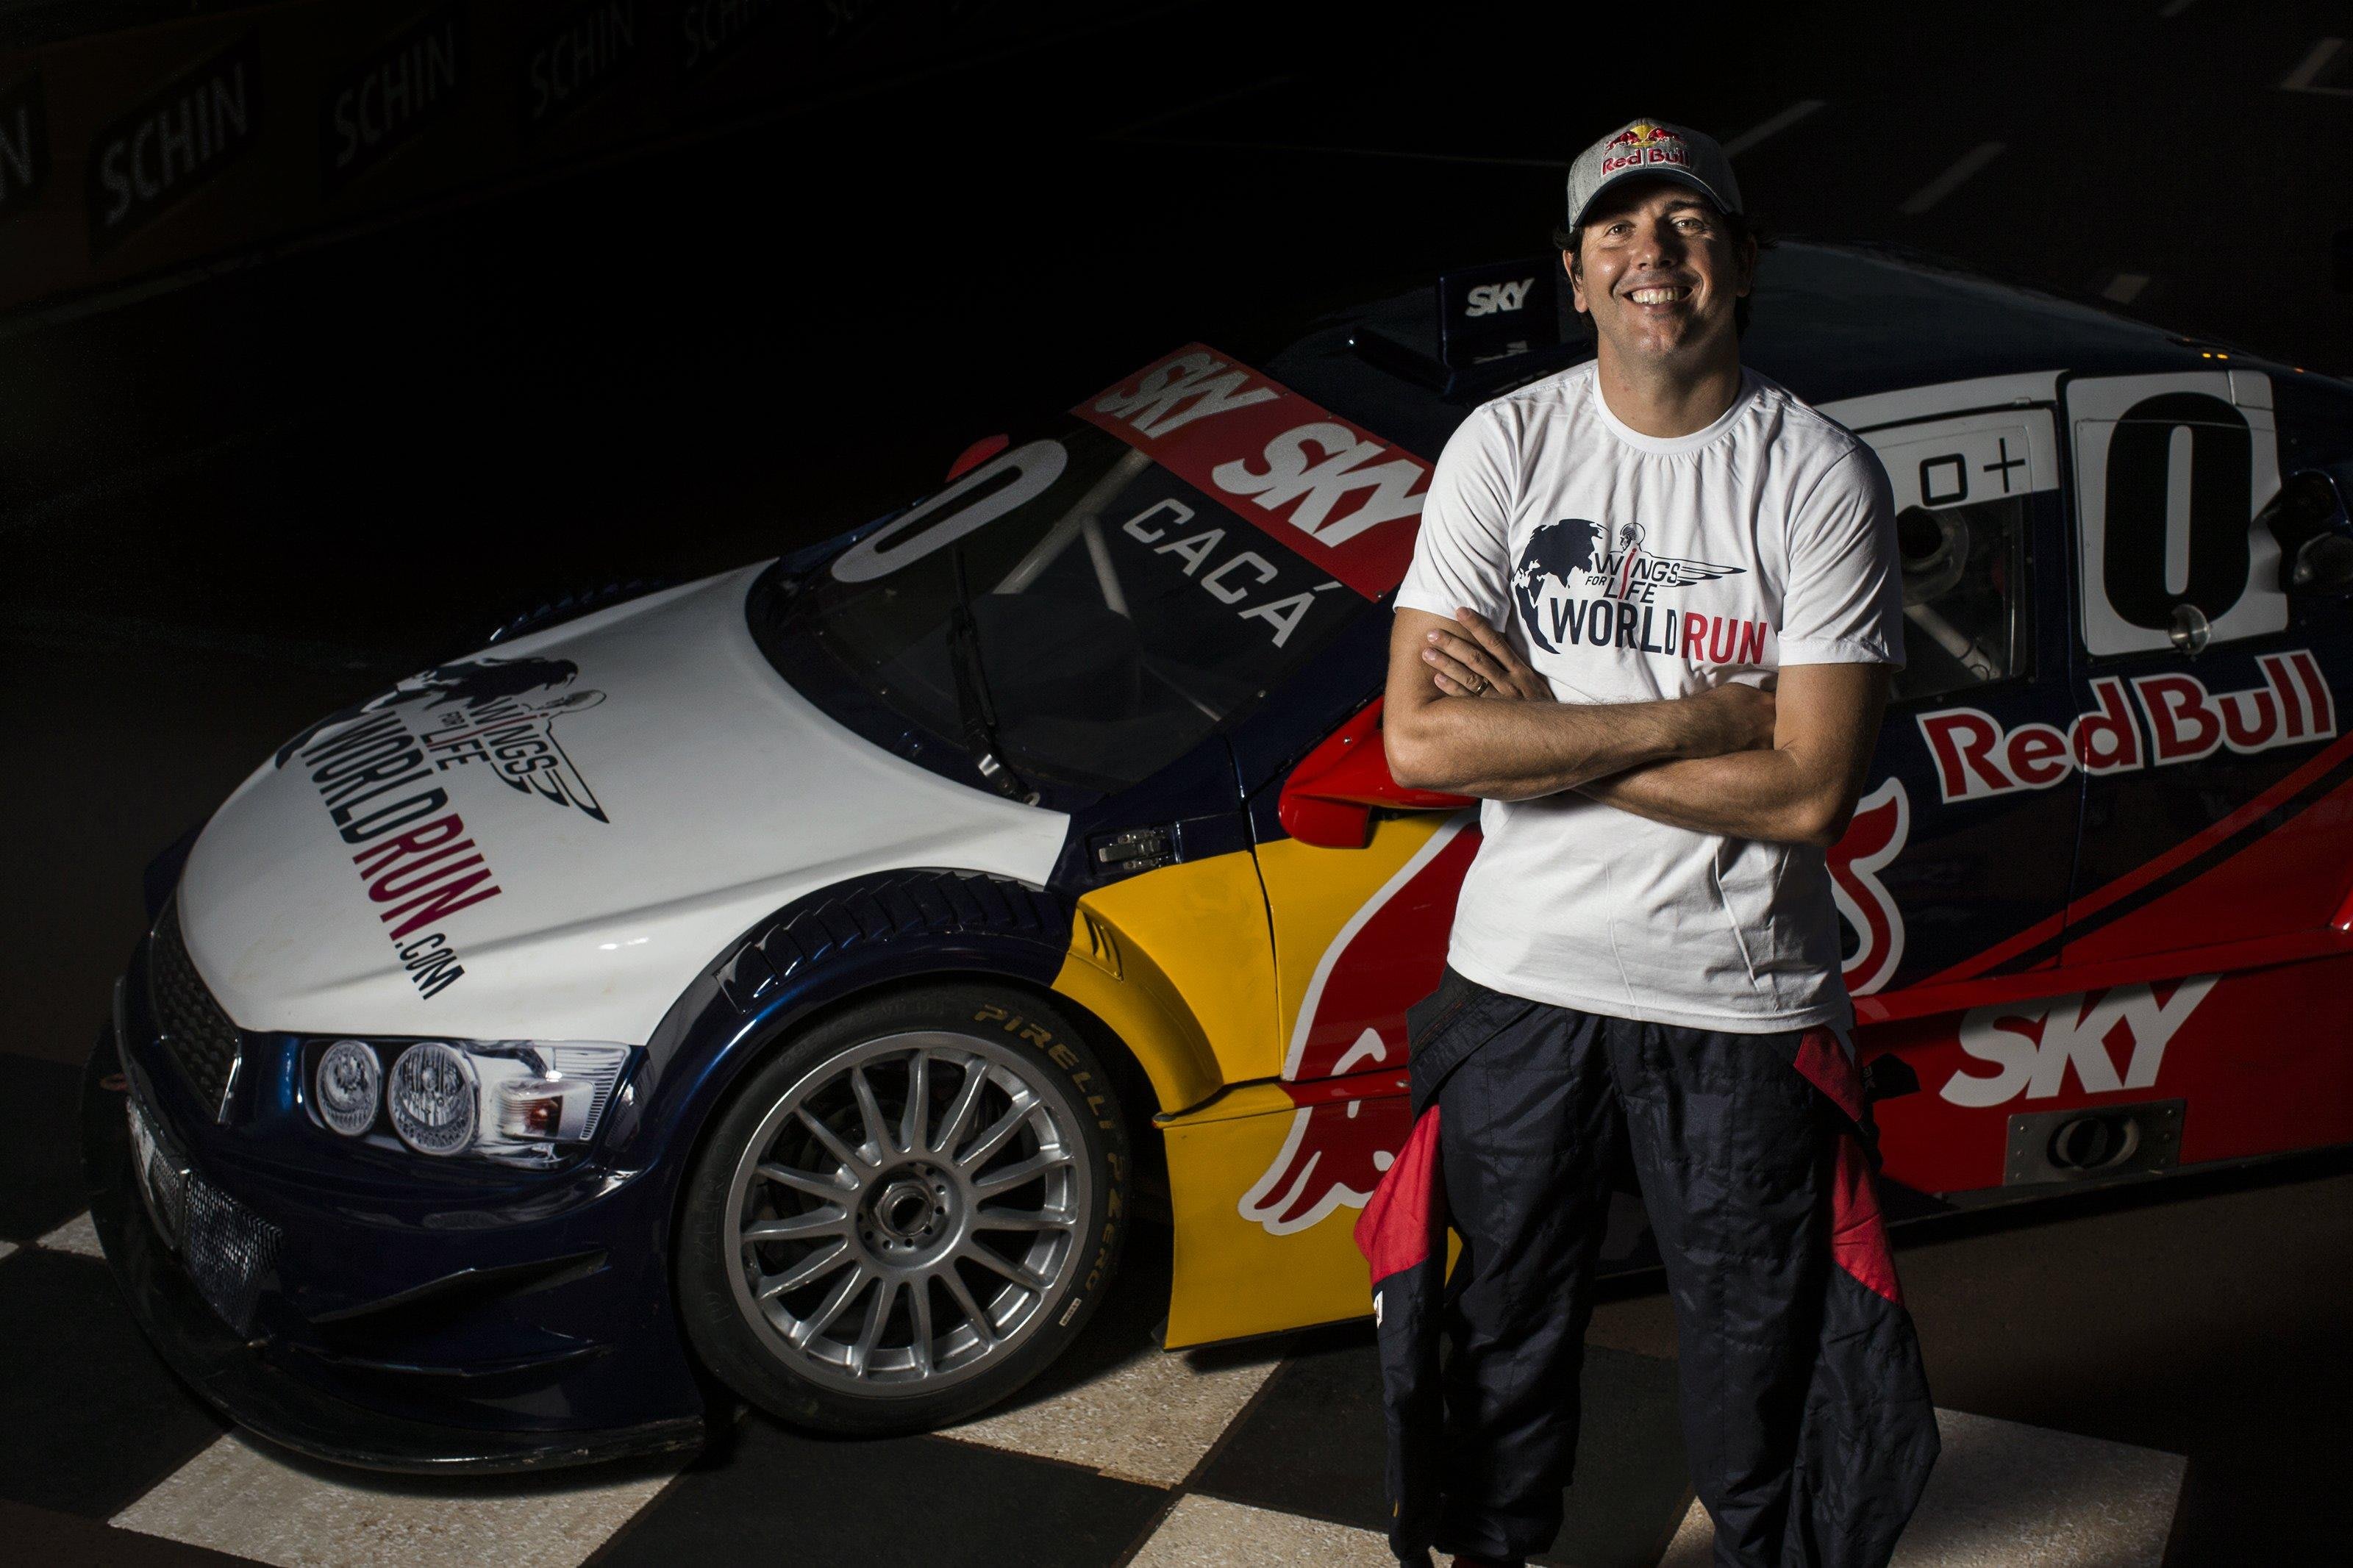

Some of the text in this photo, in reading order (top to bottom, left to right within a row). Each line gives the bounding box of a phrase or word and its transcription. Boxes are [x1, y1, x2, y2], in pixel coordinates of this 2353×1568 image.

[101, 60, 250, 226] SCHIN
[333, 21, 457, 170] SCHIN
[1602, 148, 1690, 176] Red Bull
[1465, 277, 1535, 317] SKY
[1094, 352, 1282, 440] SKY
[1211, 421, 1428, 549] SKY
[1122, 497, 1343, 649] CACÁ
[1585, 576, 1658, 604] FOR LIFE
[1594, 548, 1680, 584] WINGS
[419, 713, 493, 770] LIFE
[469, 697, 559, 778] WINGS
[1916, 649, 2337, 803] Red Bull
[1938, 973, 2224, 1108] SKY
[971, 1003, 1115, 1130] PIRELLI
[1085, 1187, 1124, 1292] ZERO
